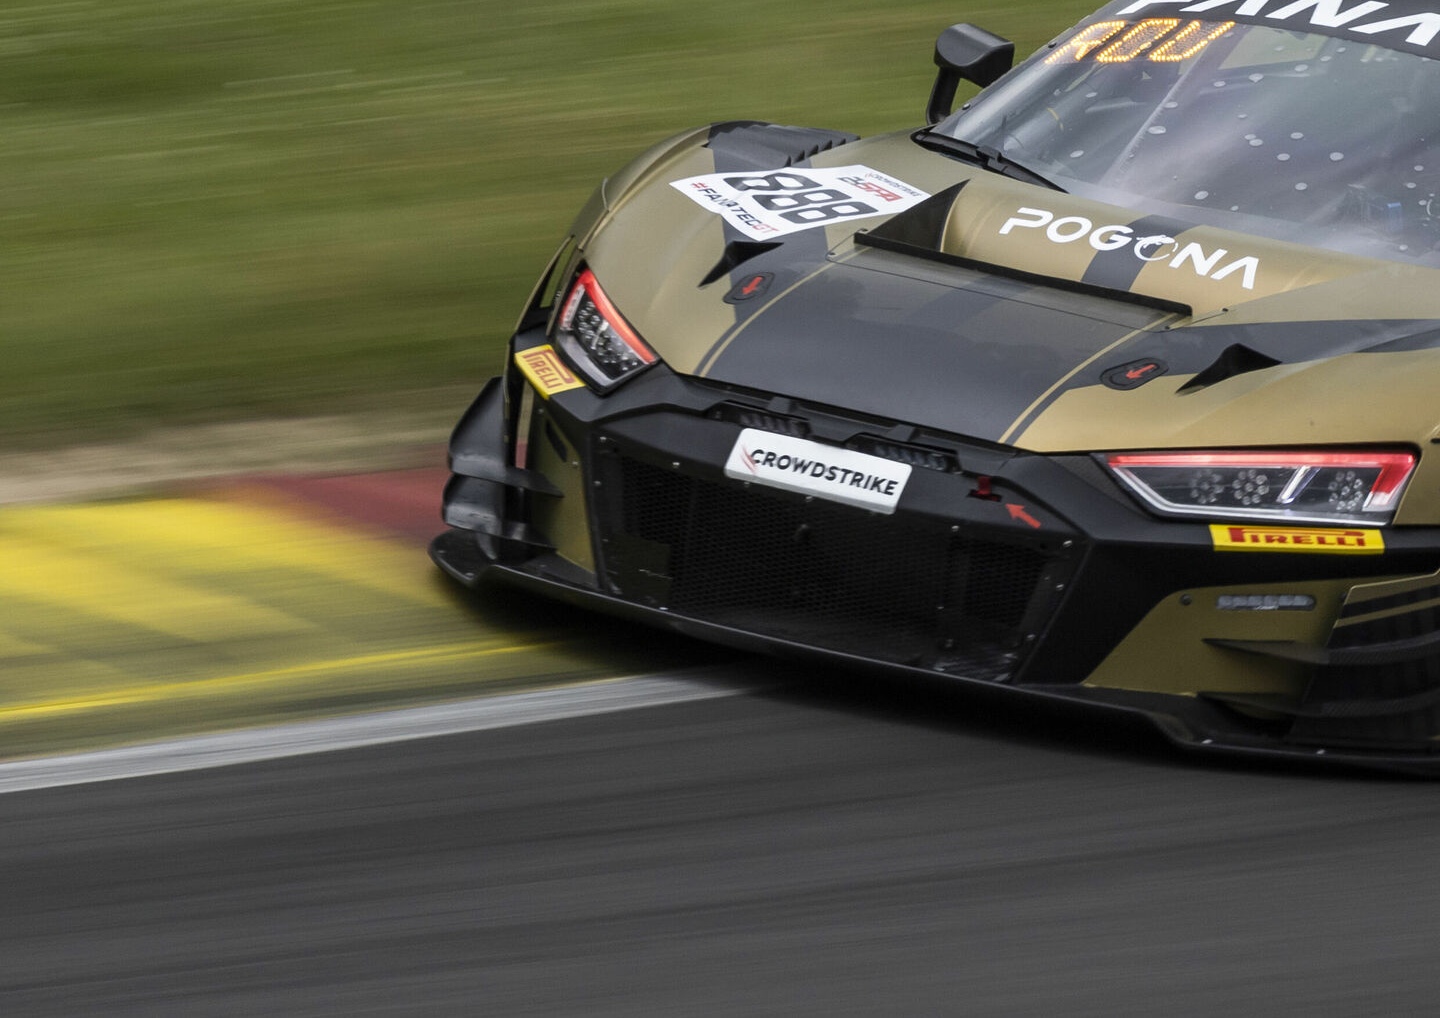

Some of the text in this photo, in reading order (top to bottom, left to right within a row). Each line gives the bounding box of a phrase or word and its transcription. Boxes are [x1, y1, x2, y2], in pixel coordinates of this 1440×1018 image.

[1044, 18, 1236, 64] ROU
[723, 172, 878, 224] 888
[522, 348, 576, 389] PIRELLI
[750, 449, 898, 496] CROWDSTRIKE
[1227, 526, 1366, 547] PIRELLI
